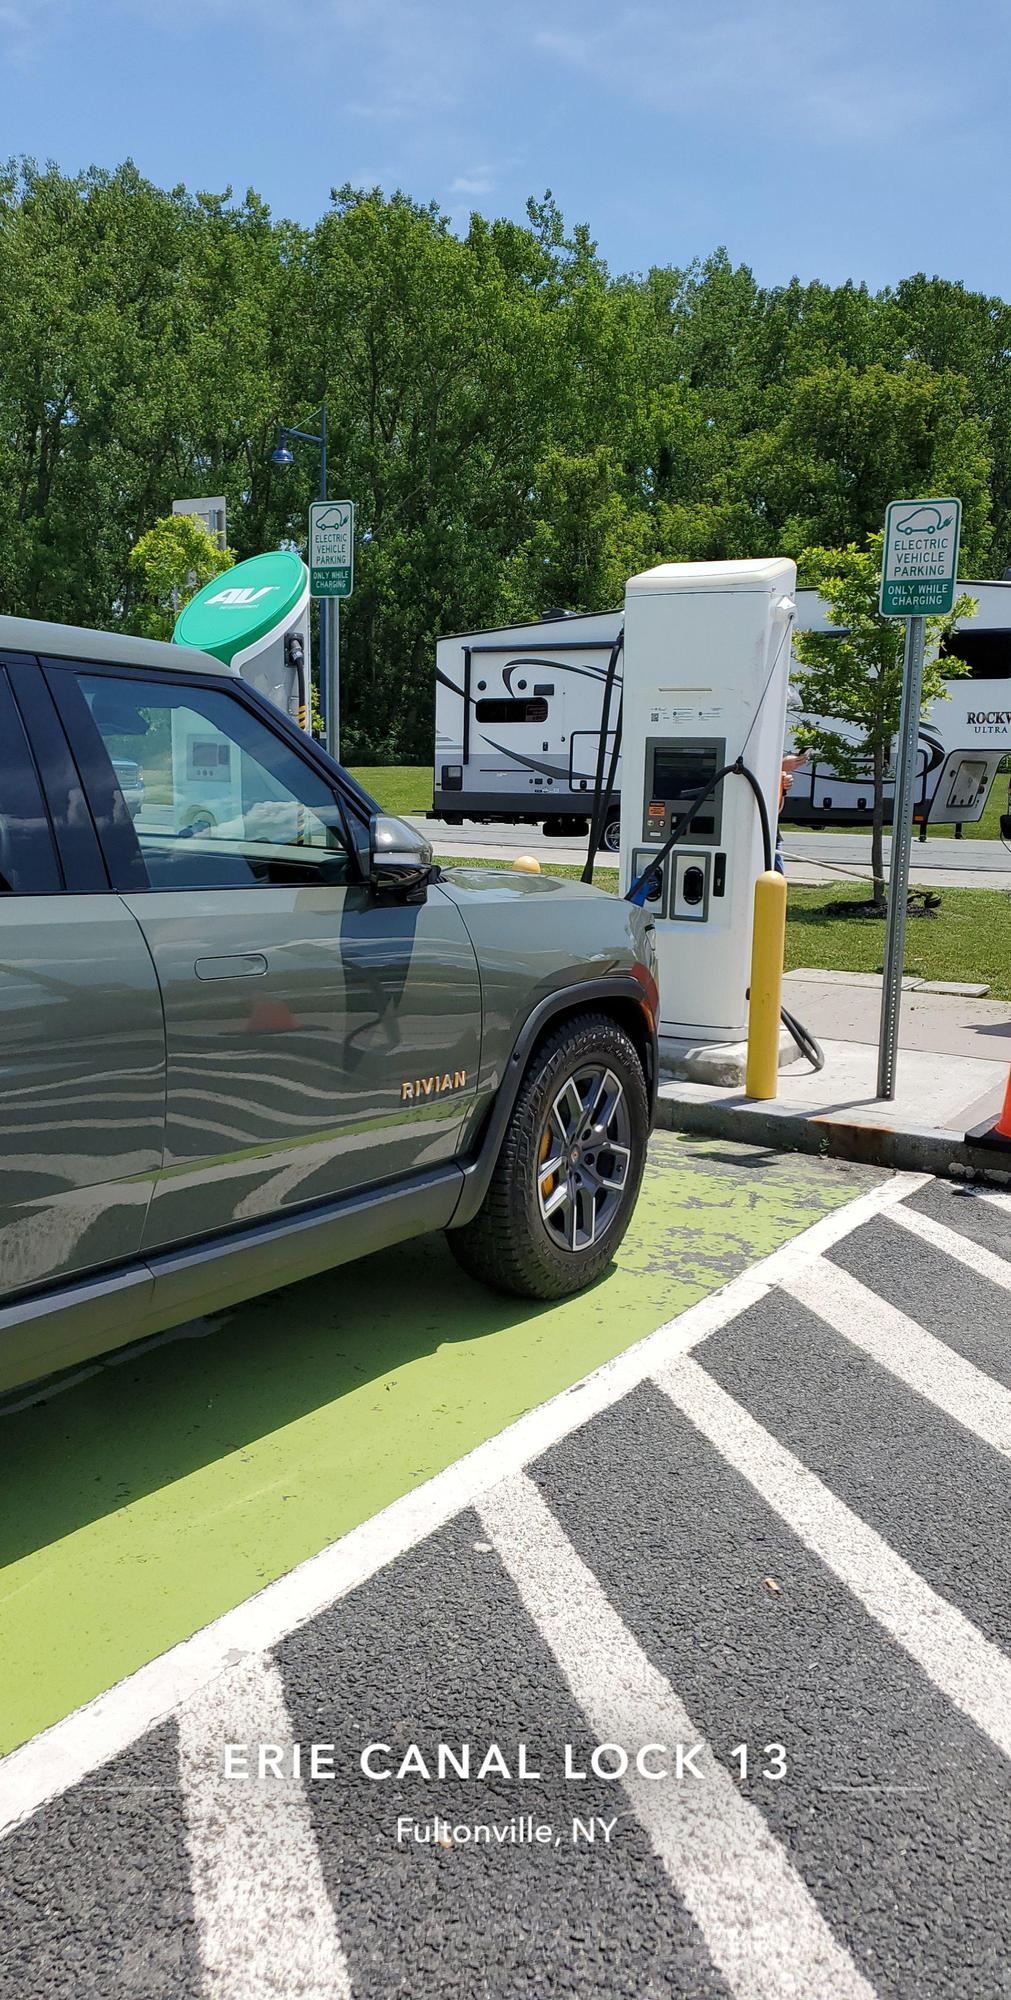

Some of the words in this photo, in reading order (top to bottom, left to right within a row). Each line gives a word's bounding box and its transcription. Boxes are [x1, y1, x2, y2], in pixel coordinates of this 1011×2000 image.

[315, 533, 348, 543] ELECTRIC
[316, 544, 346, 554] VEHICLE
[894, 538, 949, 551] ELECTRIC
[316, 555, 346, 565] PARKING
[896, 552, 945, 564] VEHICLE
[313, 572, 330, 580] ONLY
[331, 571, 348, 579] WHILE
[893, 565, 945, 577] PARKING
[315, 580, 346, 589] CHARGING
[887, 585, 915, 595] ONLY
[918, 584, 949, 594] WHILE
[891, 595, 943, 606] CHARGING
[974, 726, 1008, 734] ULTRA
[401, 1070, 467, 1100] RIVIAN
